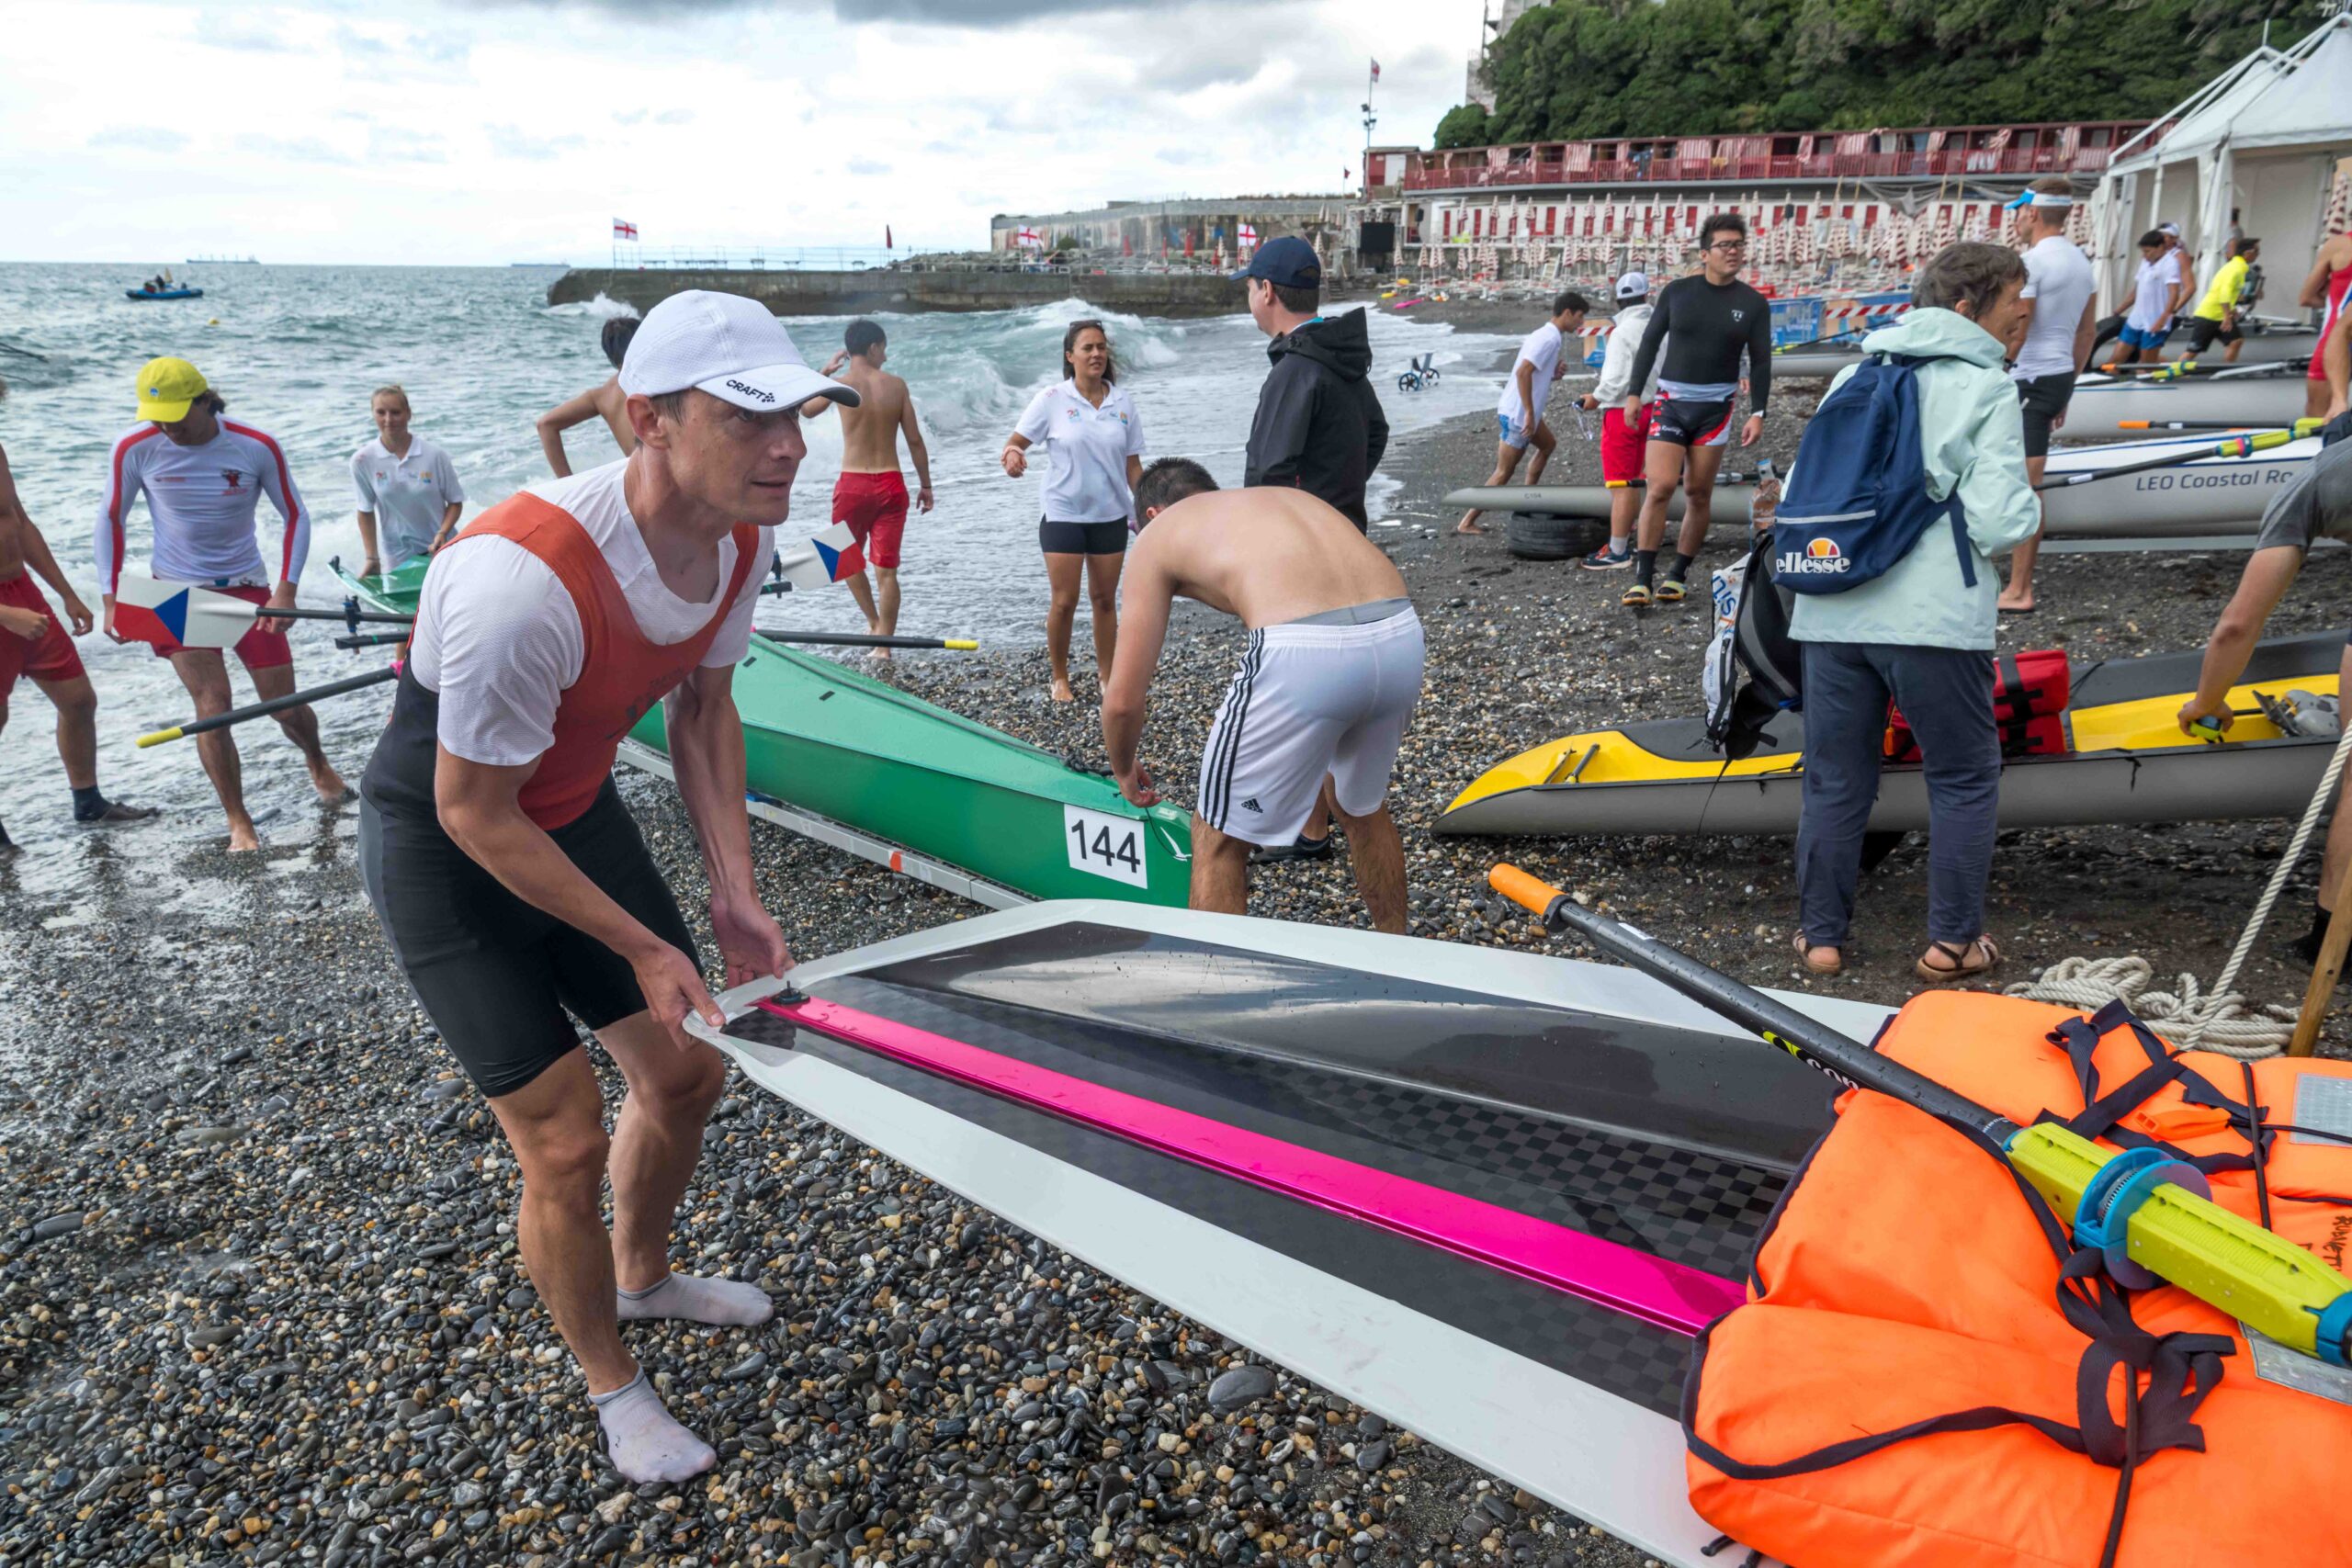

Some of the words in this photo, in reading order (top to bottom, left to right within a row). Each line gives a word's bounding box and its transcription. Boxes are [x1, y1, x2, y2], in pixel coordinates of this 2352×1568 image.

[727, 379, 766, 400] CRAFT
[2136, 476, 2174, 491] LEO
[2179, 469, 2259, 489] Coastal
[2265, 469, 2293, 484] Ro
[1776, 551, 1851, 573] ellesse
[1071, 819, 1141, 874] 144
